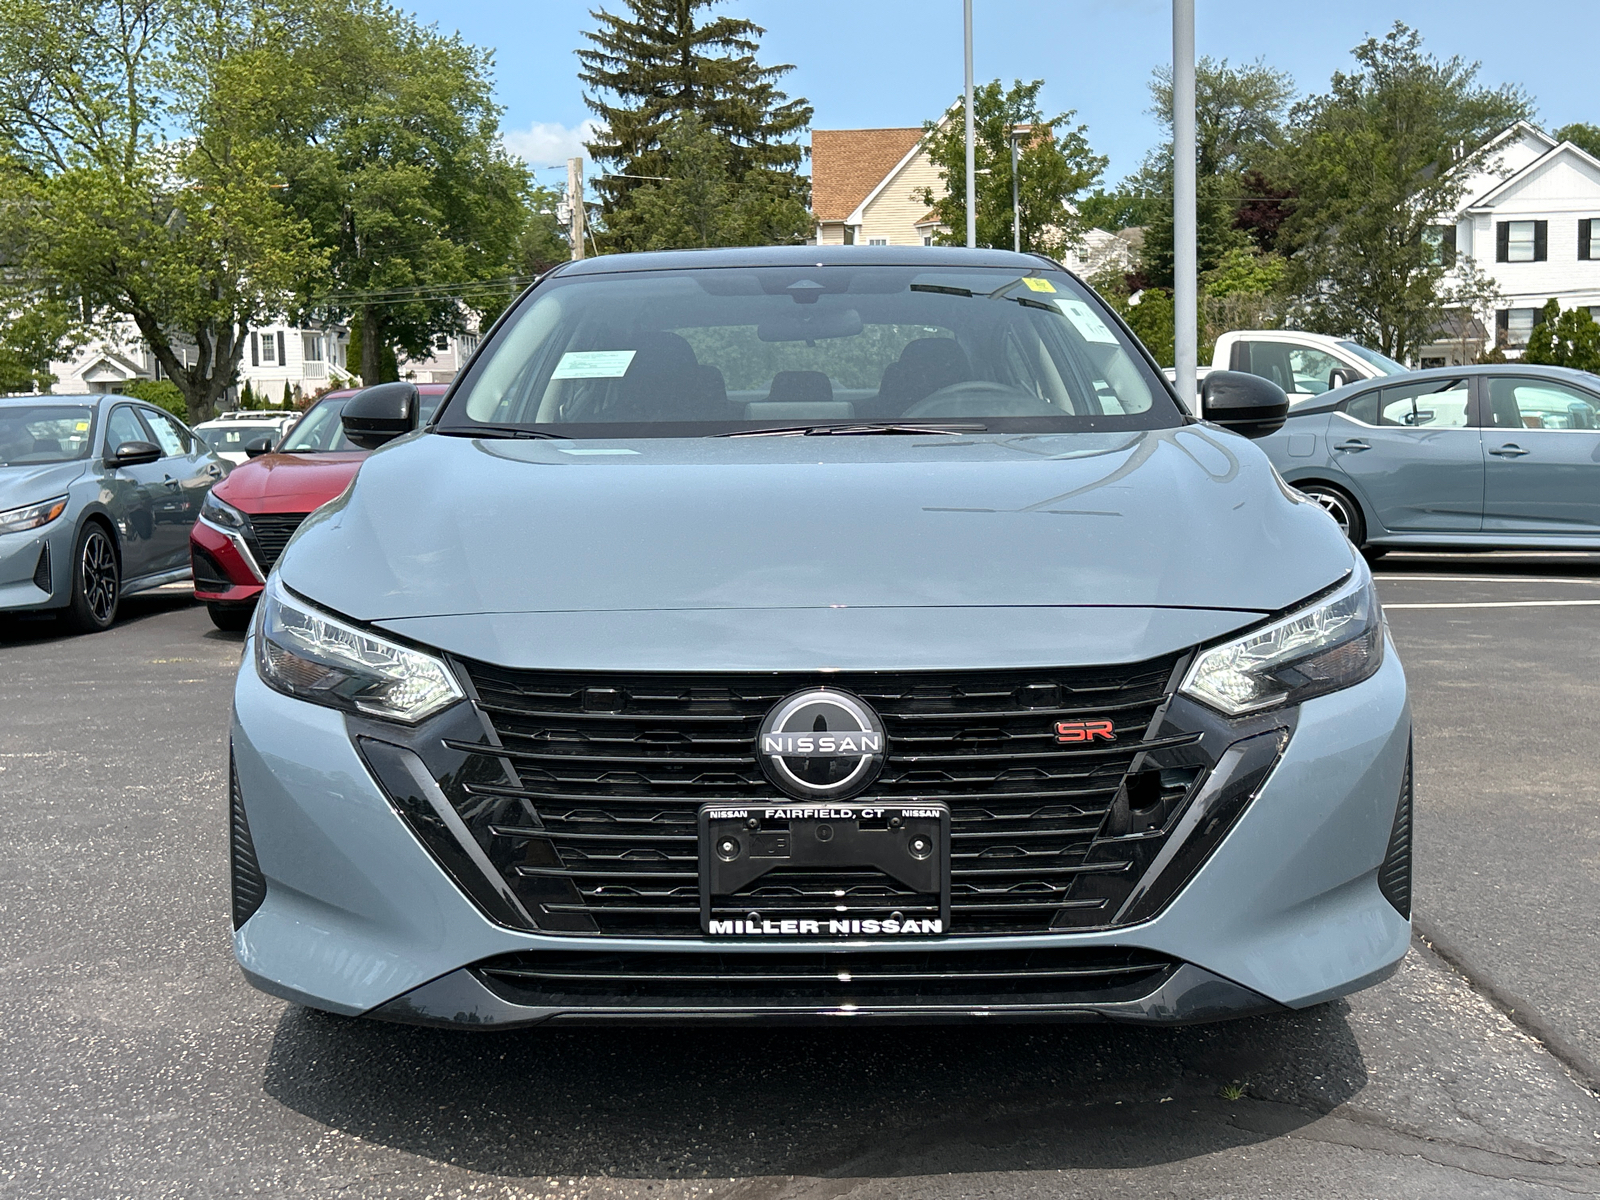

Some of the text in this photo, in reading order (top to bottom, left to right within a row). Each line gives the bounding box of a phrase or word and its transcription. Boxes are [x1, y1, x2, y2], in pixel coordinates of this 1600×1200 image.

[1057, 720, 1115, 741] SR
[765, 736, 879, 752] NISSAN
[765, 809, 885, 818] FAIRFIELD, CT
[709, 920, 942, 933] MILLER NISSAN
